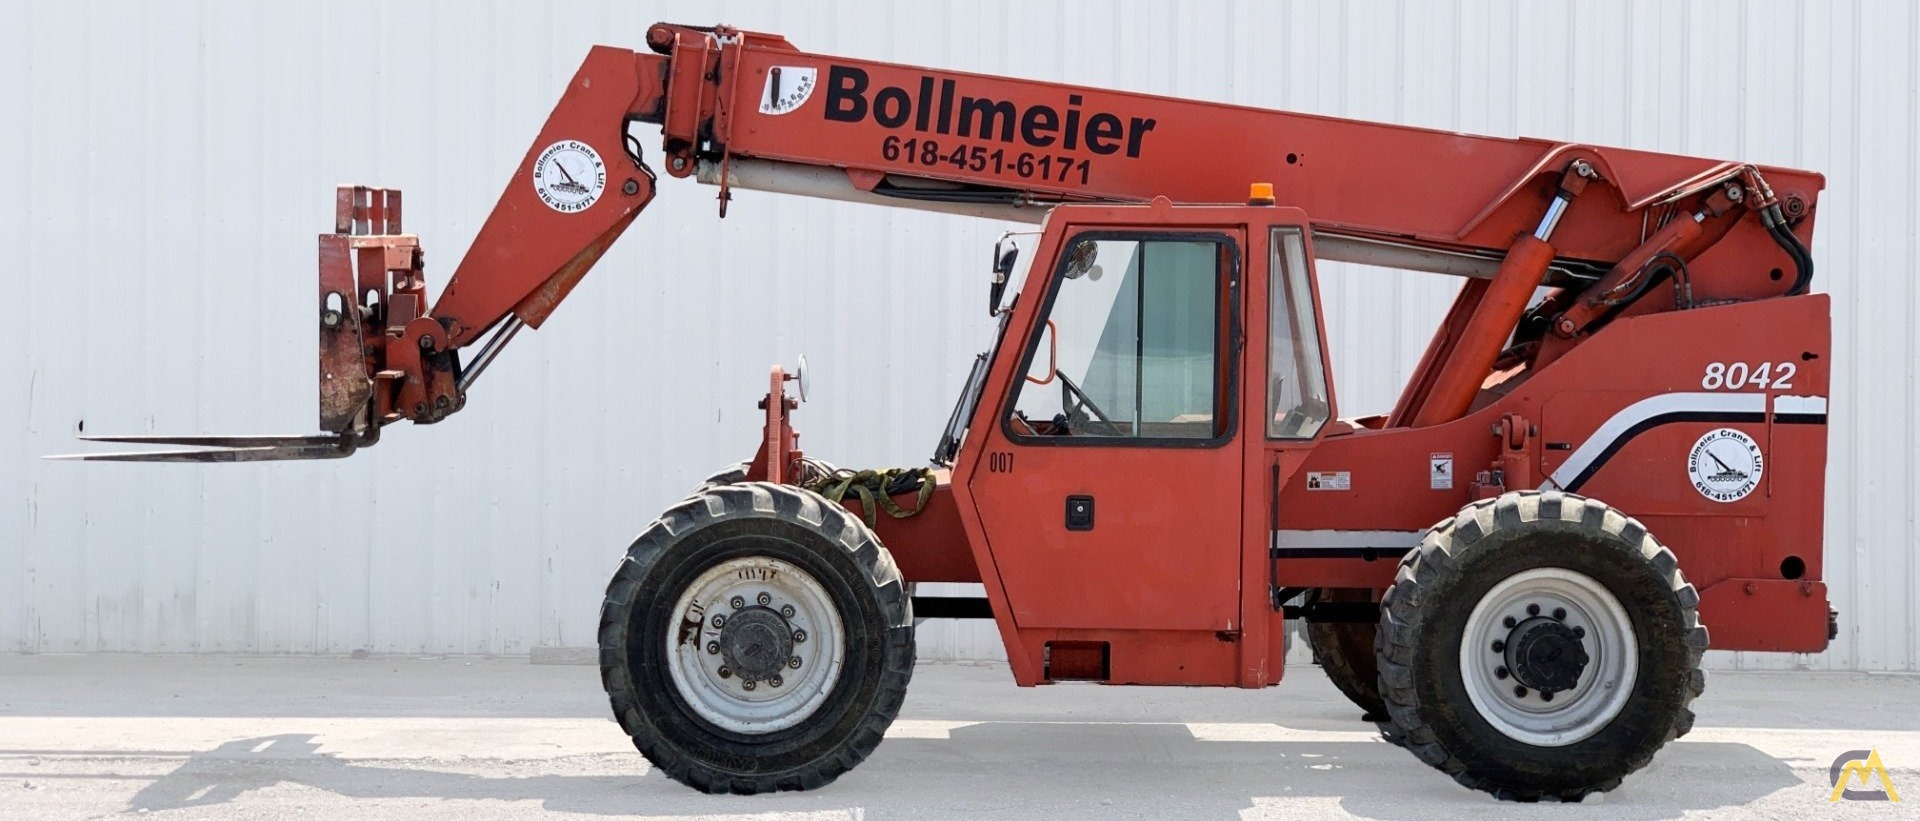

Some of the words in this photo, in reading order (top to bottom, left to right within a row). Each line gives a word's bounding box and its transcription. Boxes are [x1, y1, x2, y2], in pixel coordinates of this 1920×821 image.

[824, 65, 1156, 158] Bollmeier
[535, 144, 565, 178] Bollmeier
[570, 142, 595, 158] Crane
[882, 136, 1090, 185] 618-451-6171
[538, 188, 595, 211] 618-451-6171
[1702, 362, 1796, 389] 8042
[990, 452, 1014, 473] 007
[1690, 434, 1715, 473] Bollmeier
[1721, 430, 1748, 443] Crane
[1696, 481, 1755, 500] 618-451-6171
